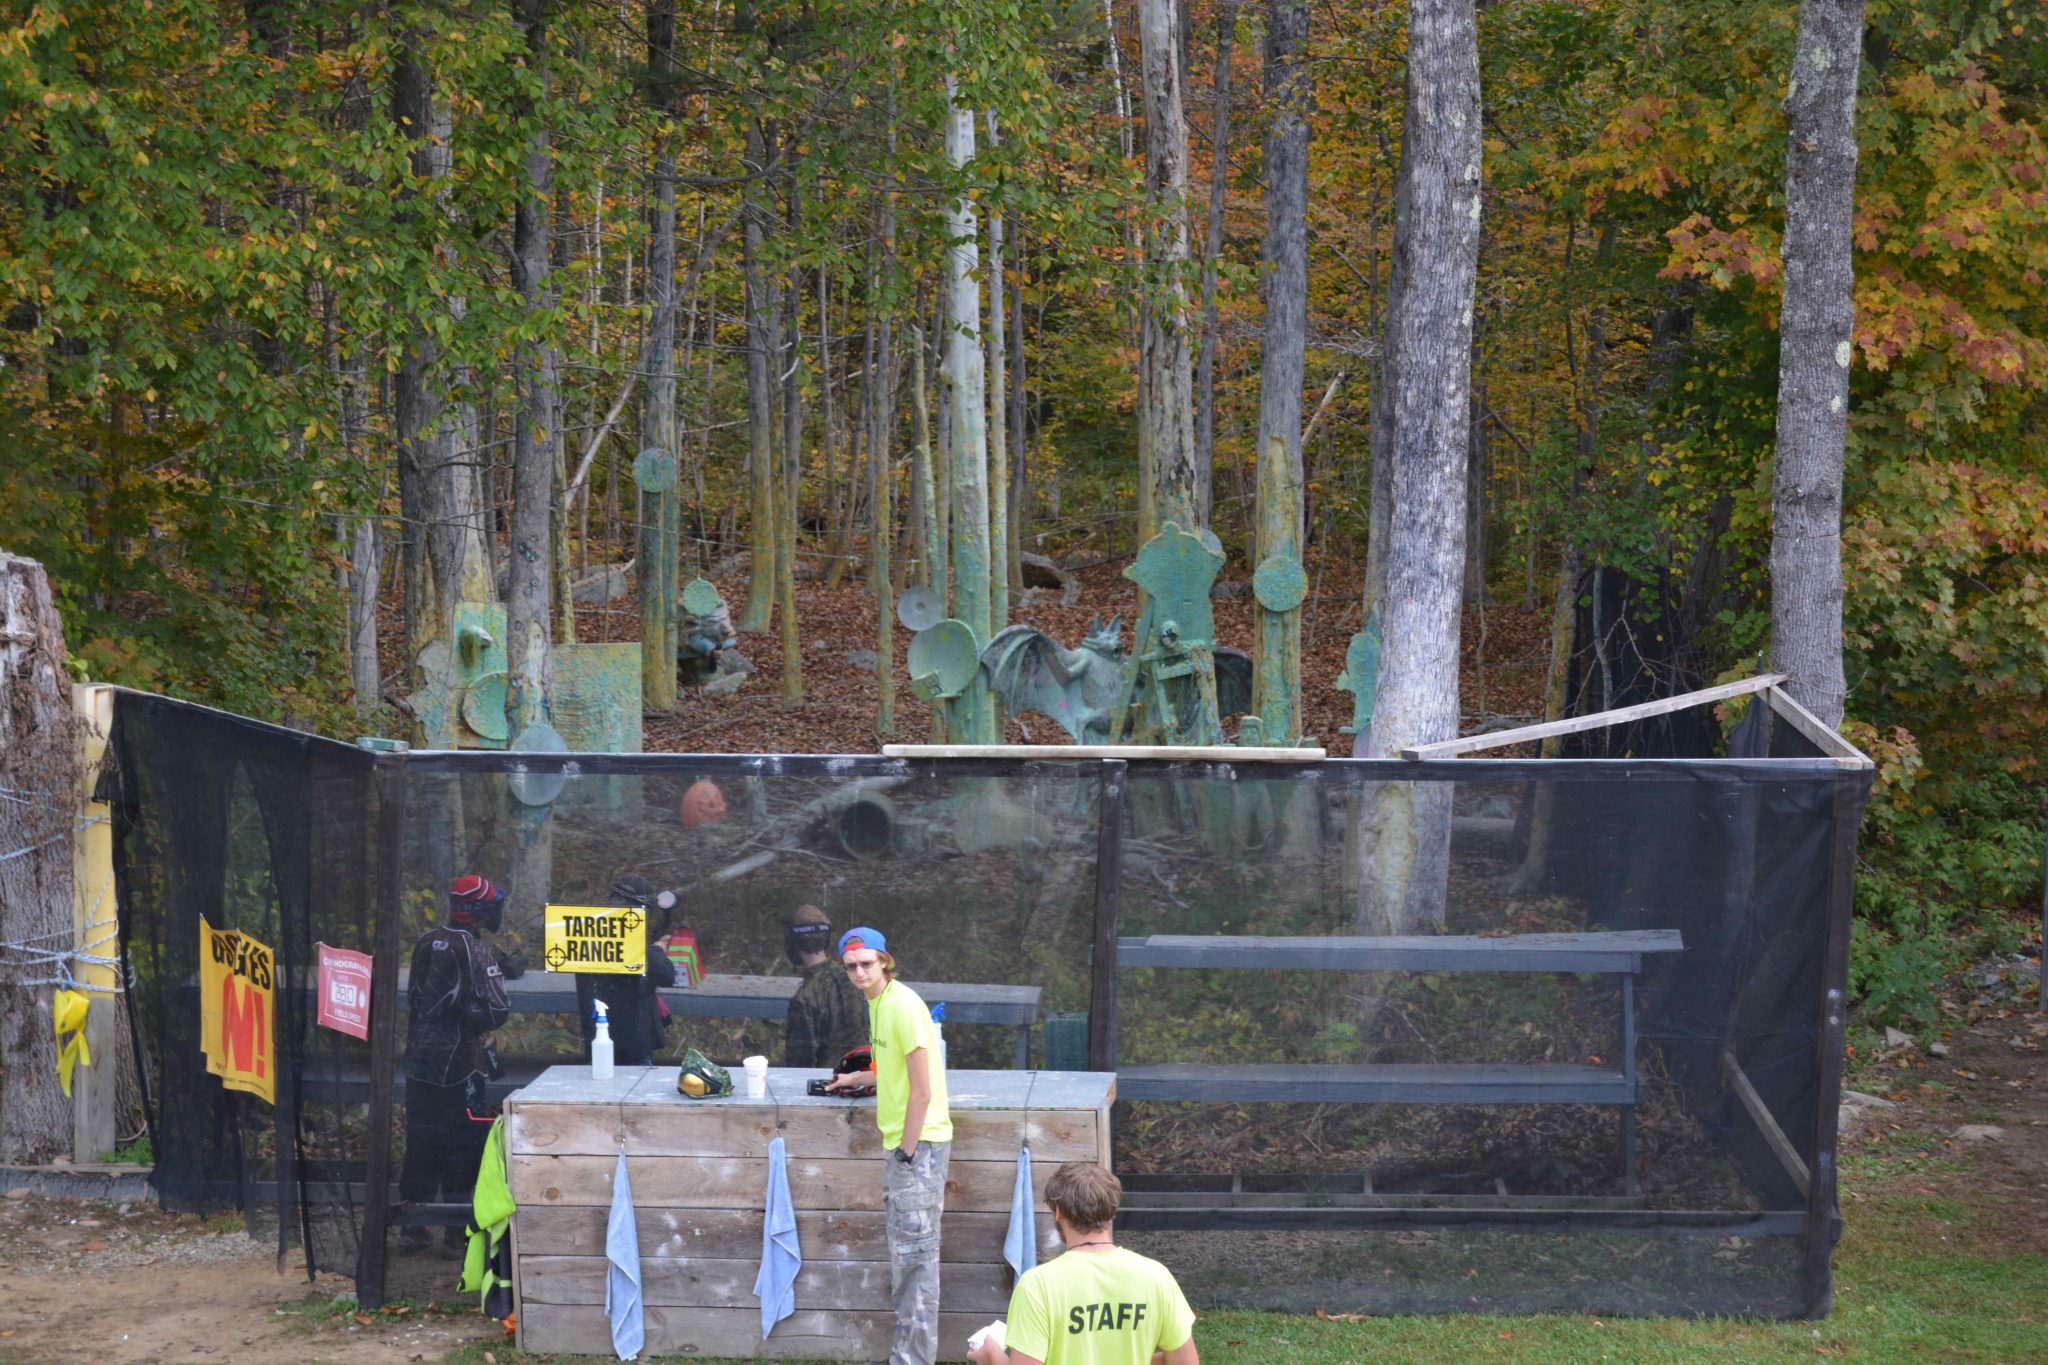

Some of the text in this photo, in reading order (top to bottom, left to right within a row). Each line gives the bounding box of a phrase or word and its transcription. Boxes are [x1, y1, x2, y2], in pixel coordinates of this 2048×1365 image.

[563, 916, 627, 938] TARGET
[567, 940, 624, 962] RANGE
[1068, 1302, 1147, 1335] STAFF
